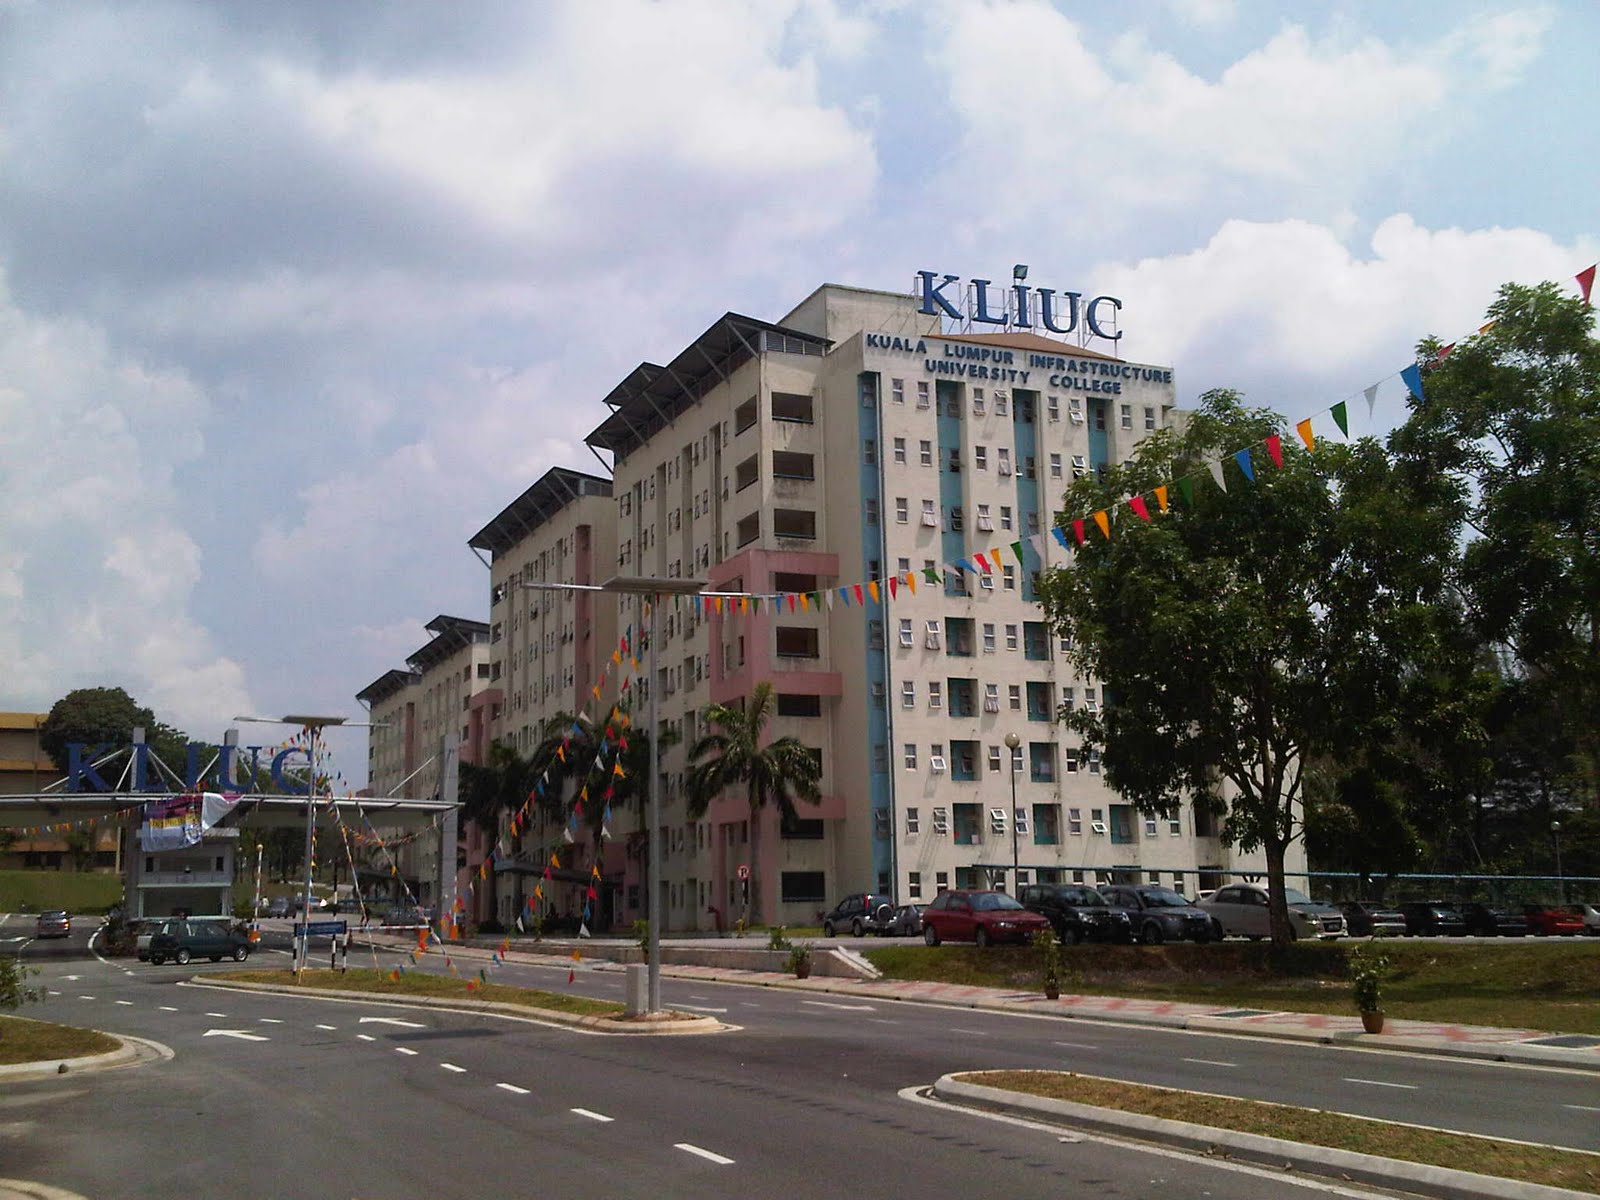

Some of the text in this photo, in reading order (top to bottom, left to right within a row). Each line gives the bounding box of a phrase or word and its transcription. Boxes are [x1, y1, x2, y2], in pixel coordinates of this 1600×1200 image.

[867, 333, 1172, 384] KUALA LUMPUR INFRASTRUCTURE
[925, 359, 1122, 395] UNIVERSITY COLLEGE
[65, 742, 314, 793] KLIUC
